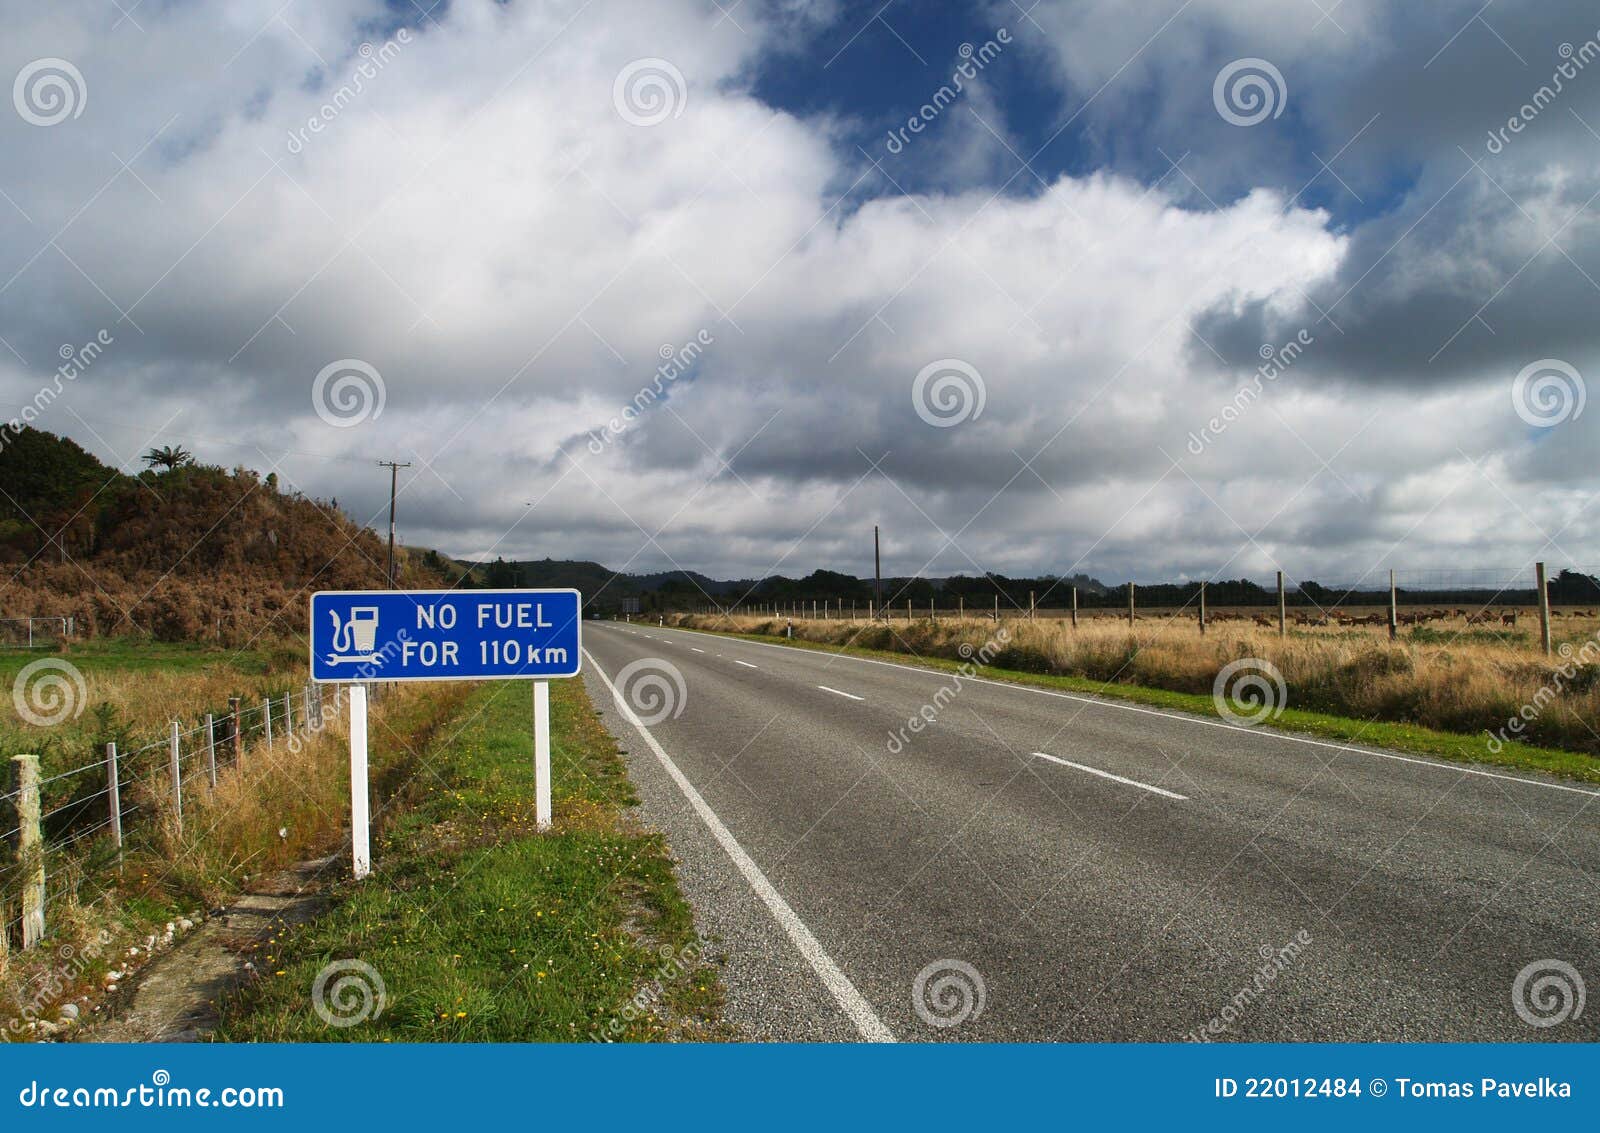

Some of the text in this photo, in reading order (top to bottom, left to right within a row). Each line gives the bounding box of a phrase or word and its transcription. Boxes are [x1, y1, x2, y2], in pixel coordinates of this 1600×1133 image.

[416, 603, 553, 630] NO FUEL
[402, 641, 460, 667] FOR
